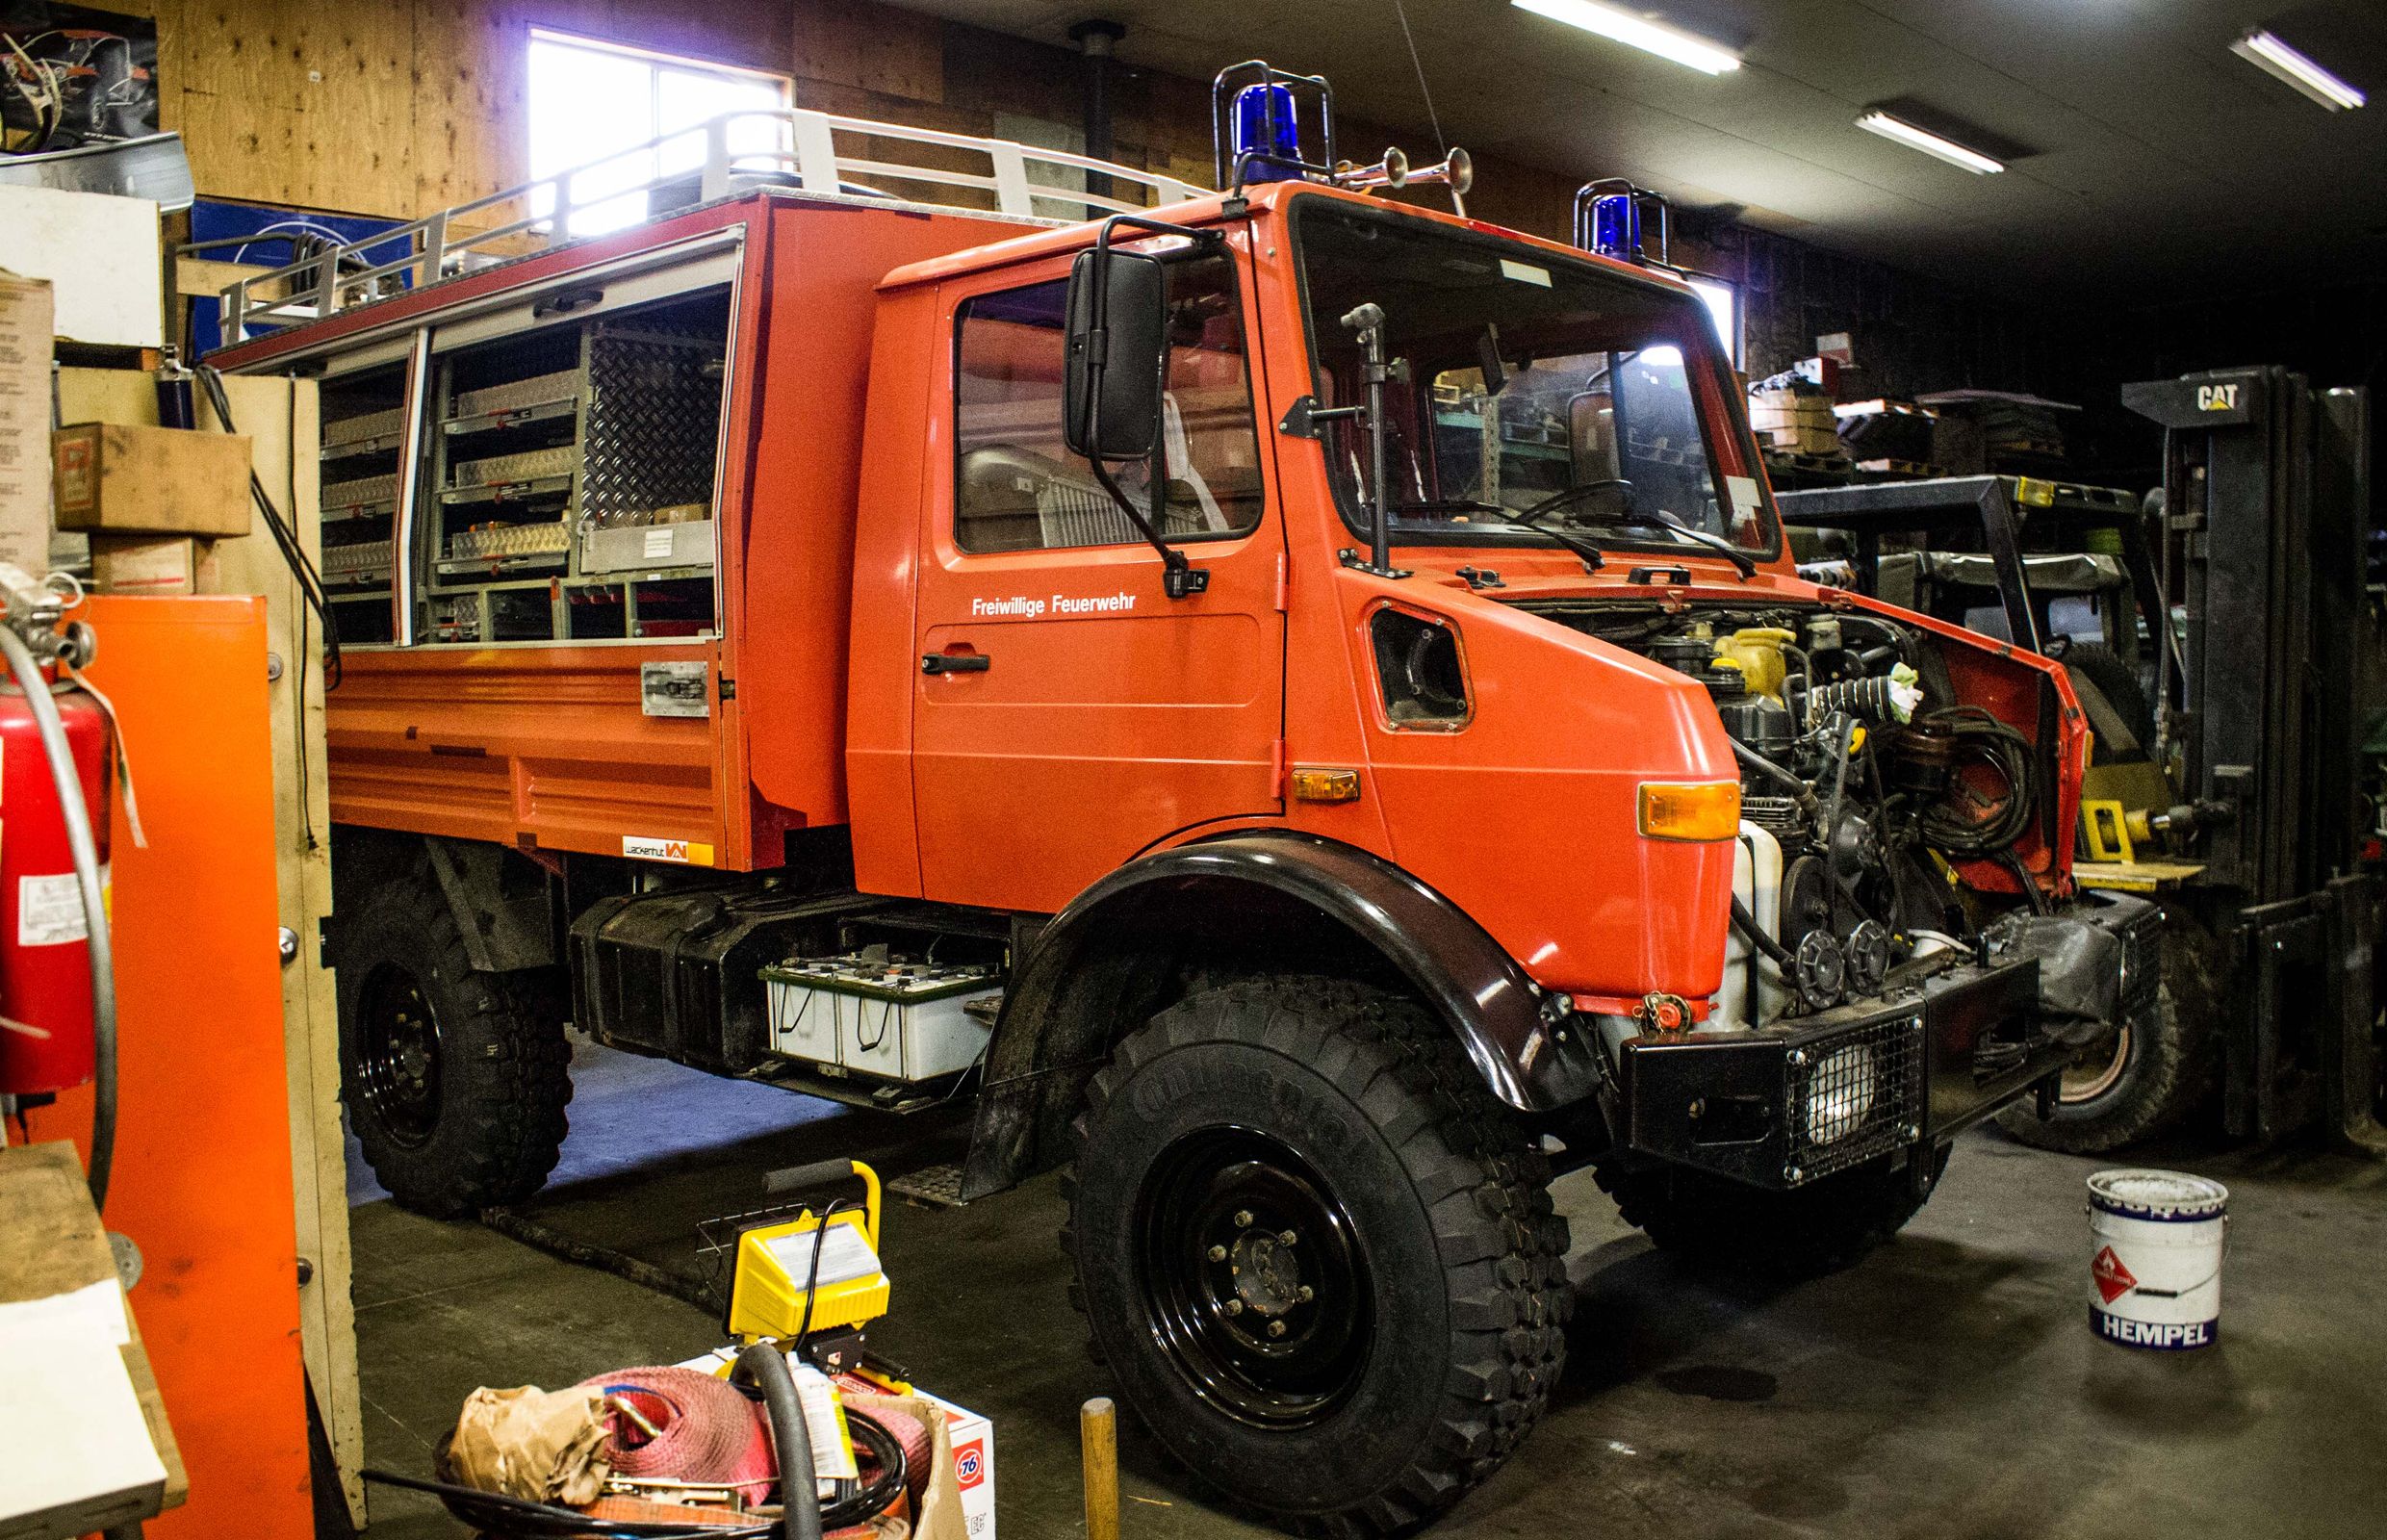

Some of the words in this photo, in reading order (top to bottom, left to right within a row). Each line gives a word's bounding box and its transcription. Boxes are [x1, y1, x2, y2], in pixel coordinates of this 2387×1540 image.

[2197, 384, 2238, 411] CAT
[972, 598, 1045, 618] Freiwillige
[1052, 592, 1136, 613] Feuerwehr
[2103, 1314, 2208, 1348] HEMPEL
[961, 1454, 978, 1476] 76
